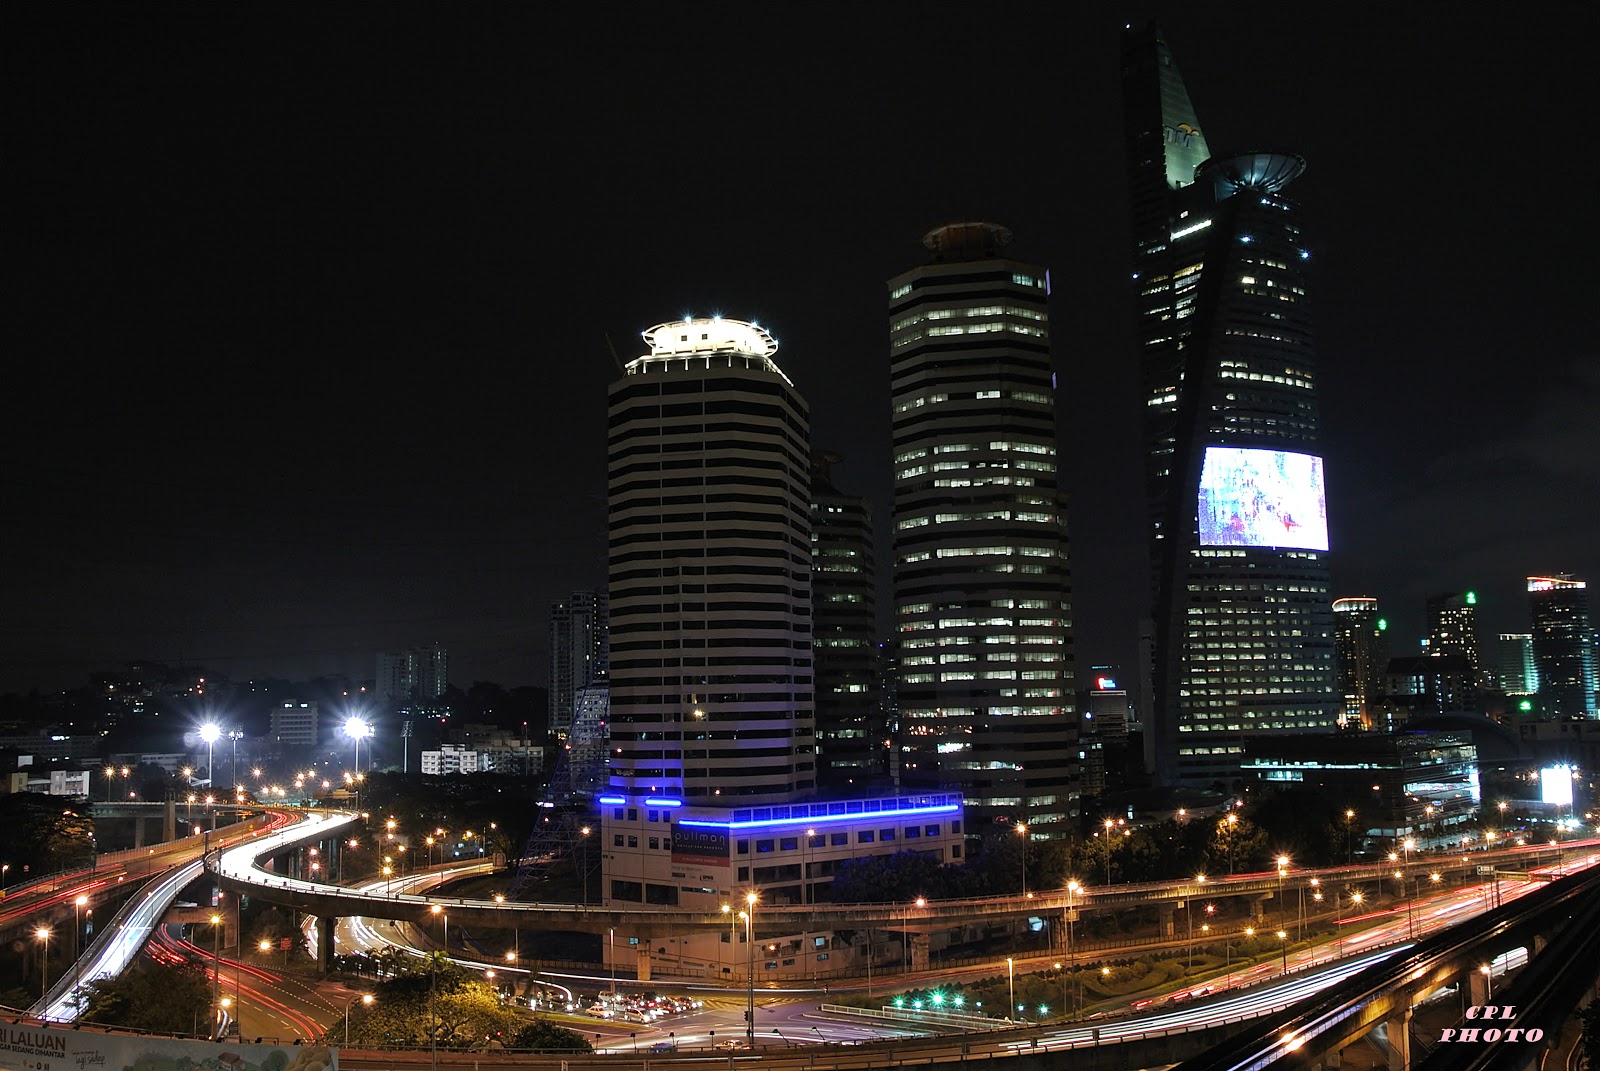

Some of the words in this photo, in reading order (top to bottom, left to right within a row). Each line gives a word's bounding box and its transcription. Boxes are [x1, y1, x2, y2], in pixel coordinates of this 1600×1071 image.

[674, 831, 725, 846] pullman
[10, 1030, 66, 1051] LALUAN
[11, 1045, 35, 1055] SEDANG
[35, 1048, 65, 1059] DIHANTAR
